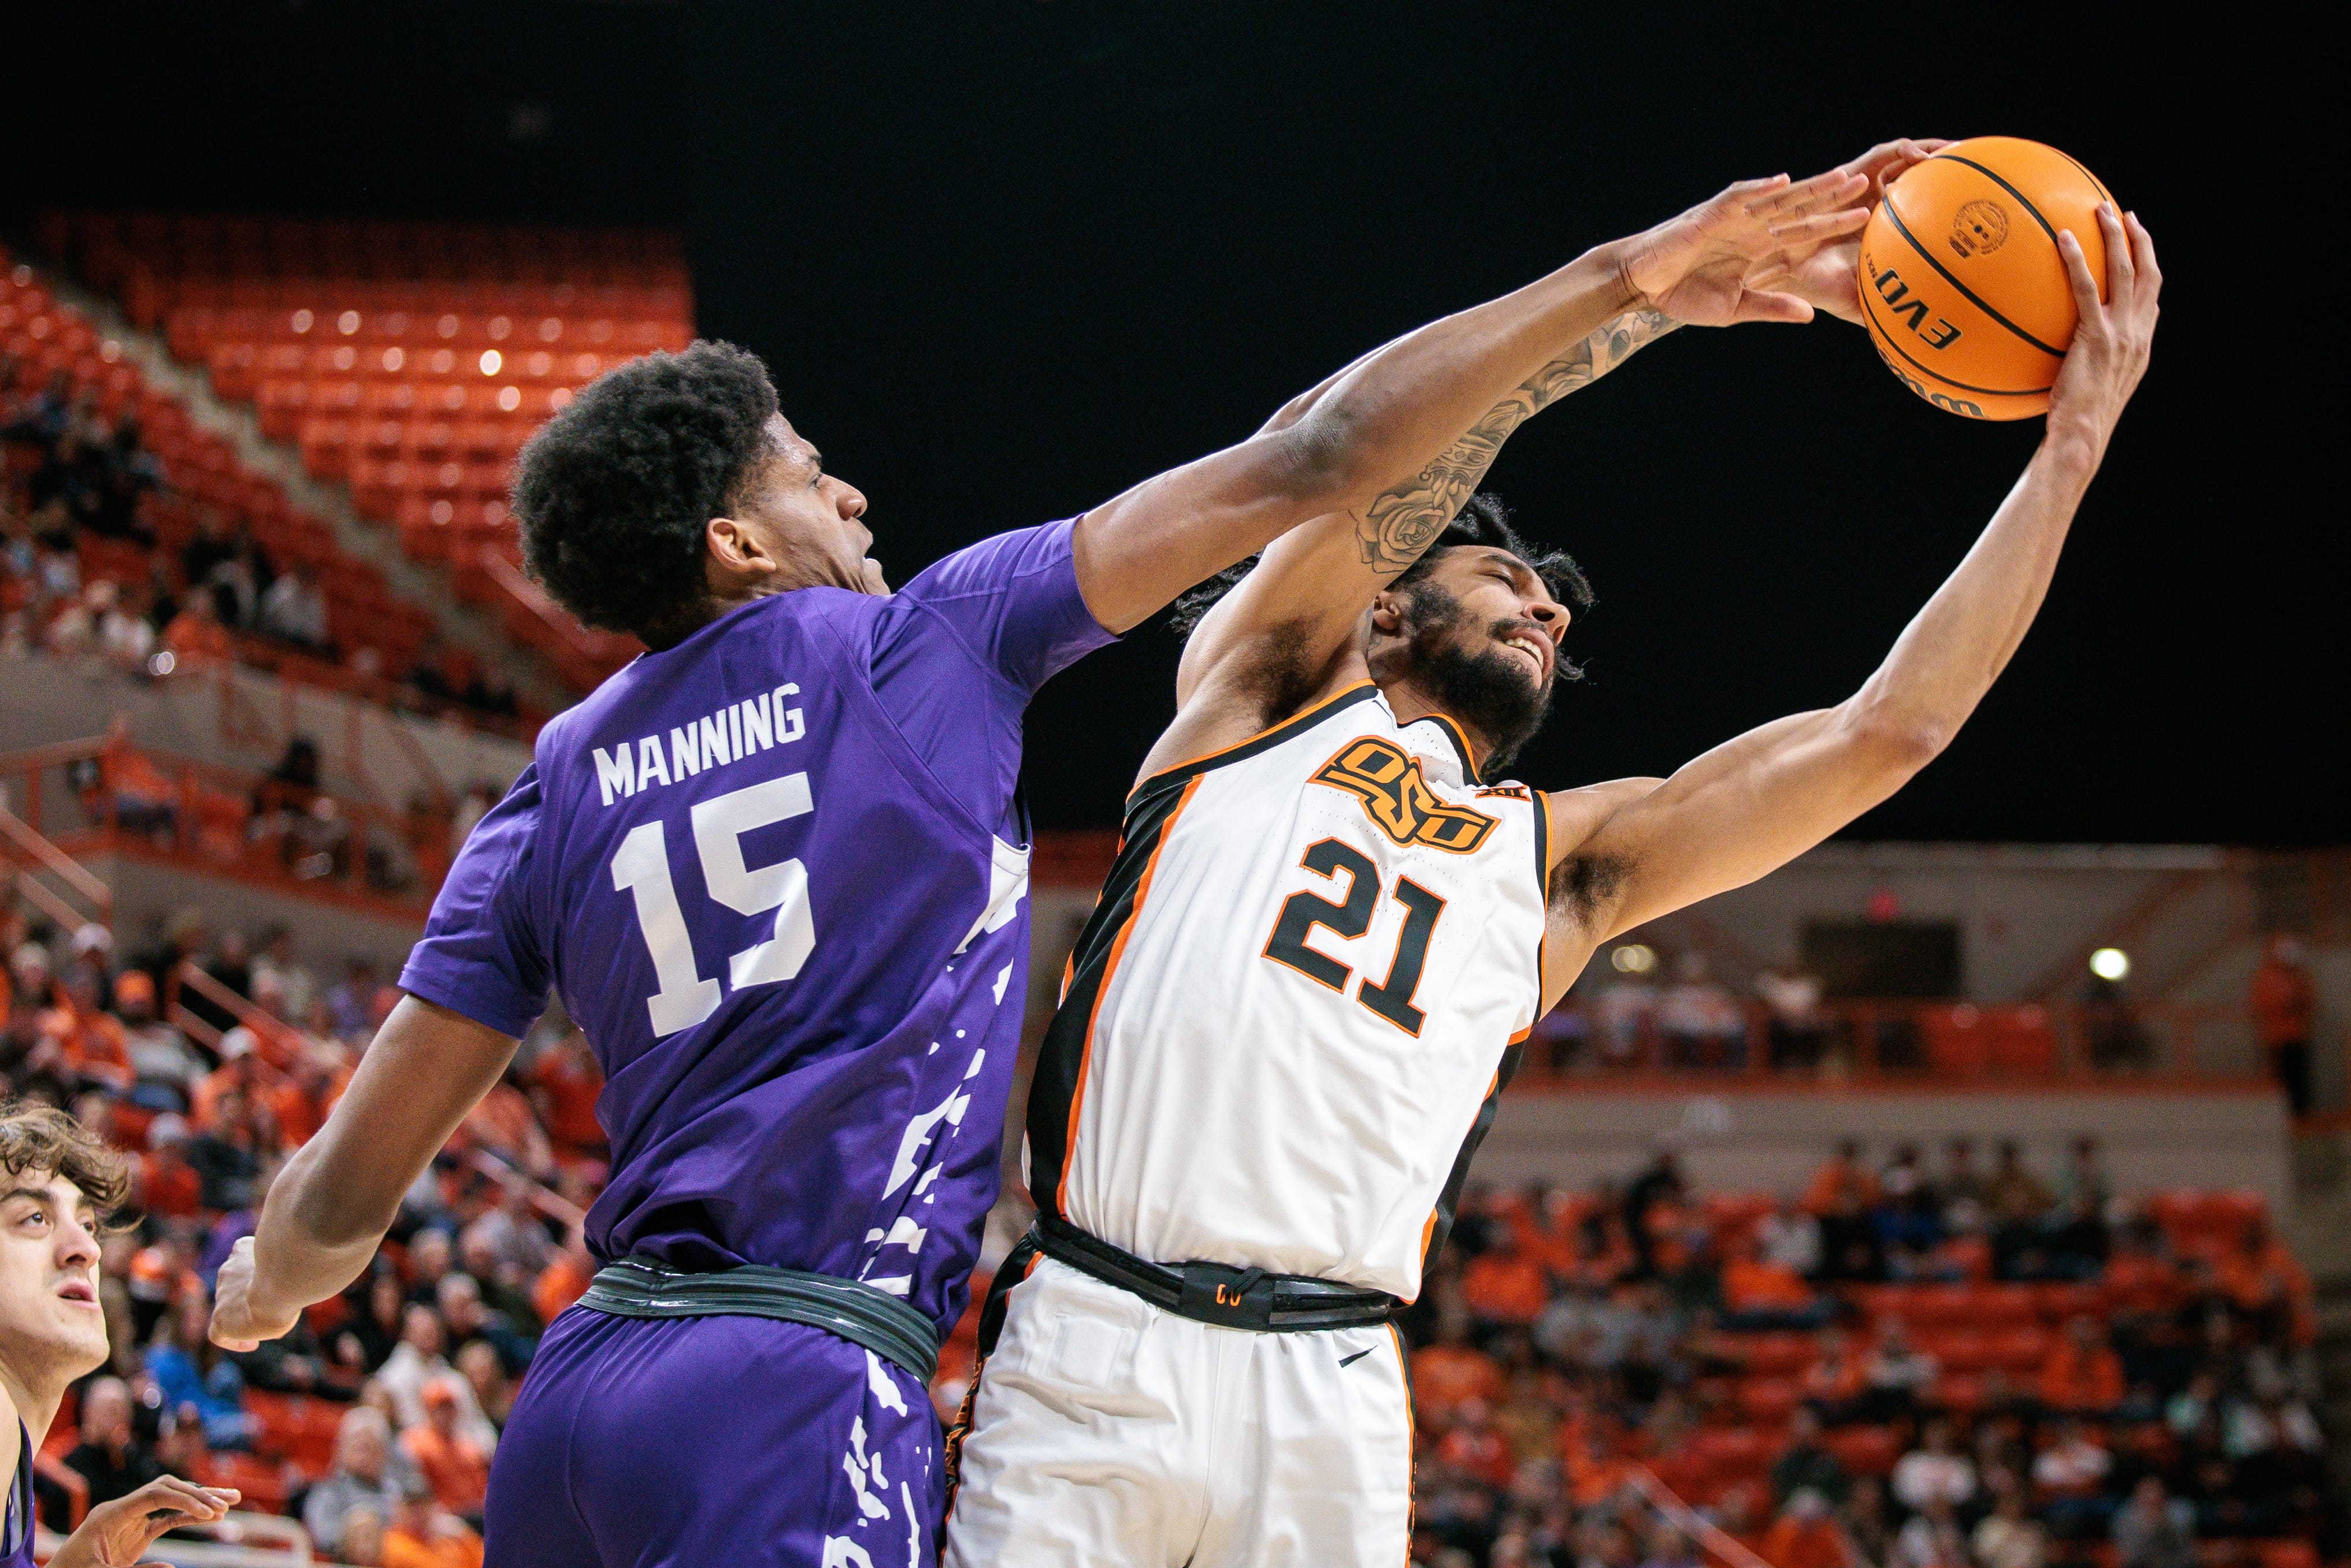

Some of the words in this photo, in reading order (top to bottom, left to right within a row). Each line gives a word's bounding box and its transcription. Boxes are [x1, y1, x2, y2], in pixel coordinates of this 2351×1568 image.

[1875, 268, 1963, 350] EVO
[592, 682, 806, 806] MANNING
[1306, 734, 1502, 855] OSU
[610, 771, 816, 1038] 15
[1260, 836, 1448, 1039] 21
